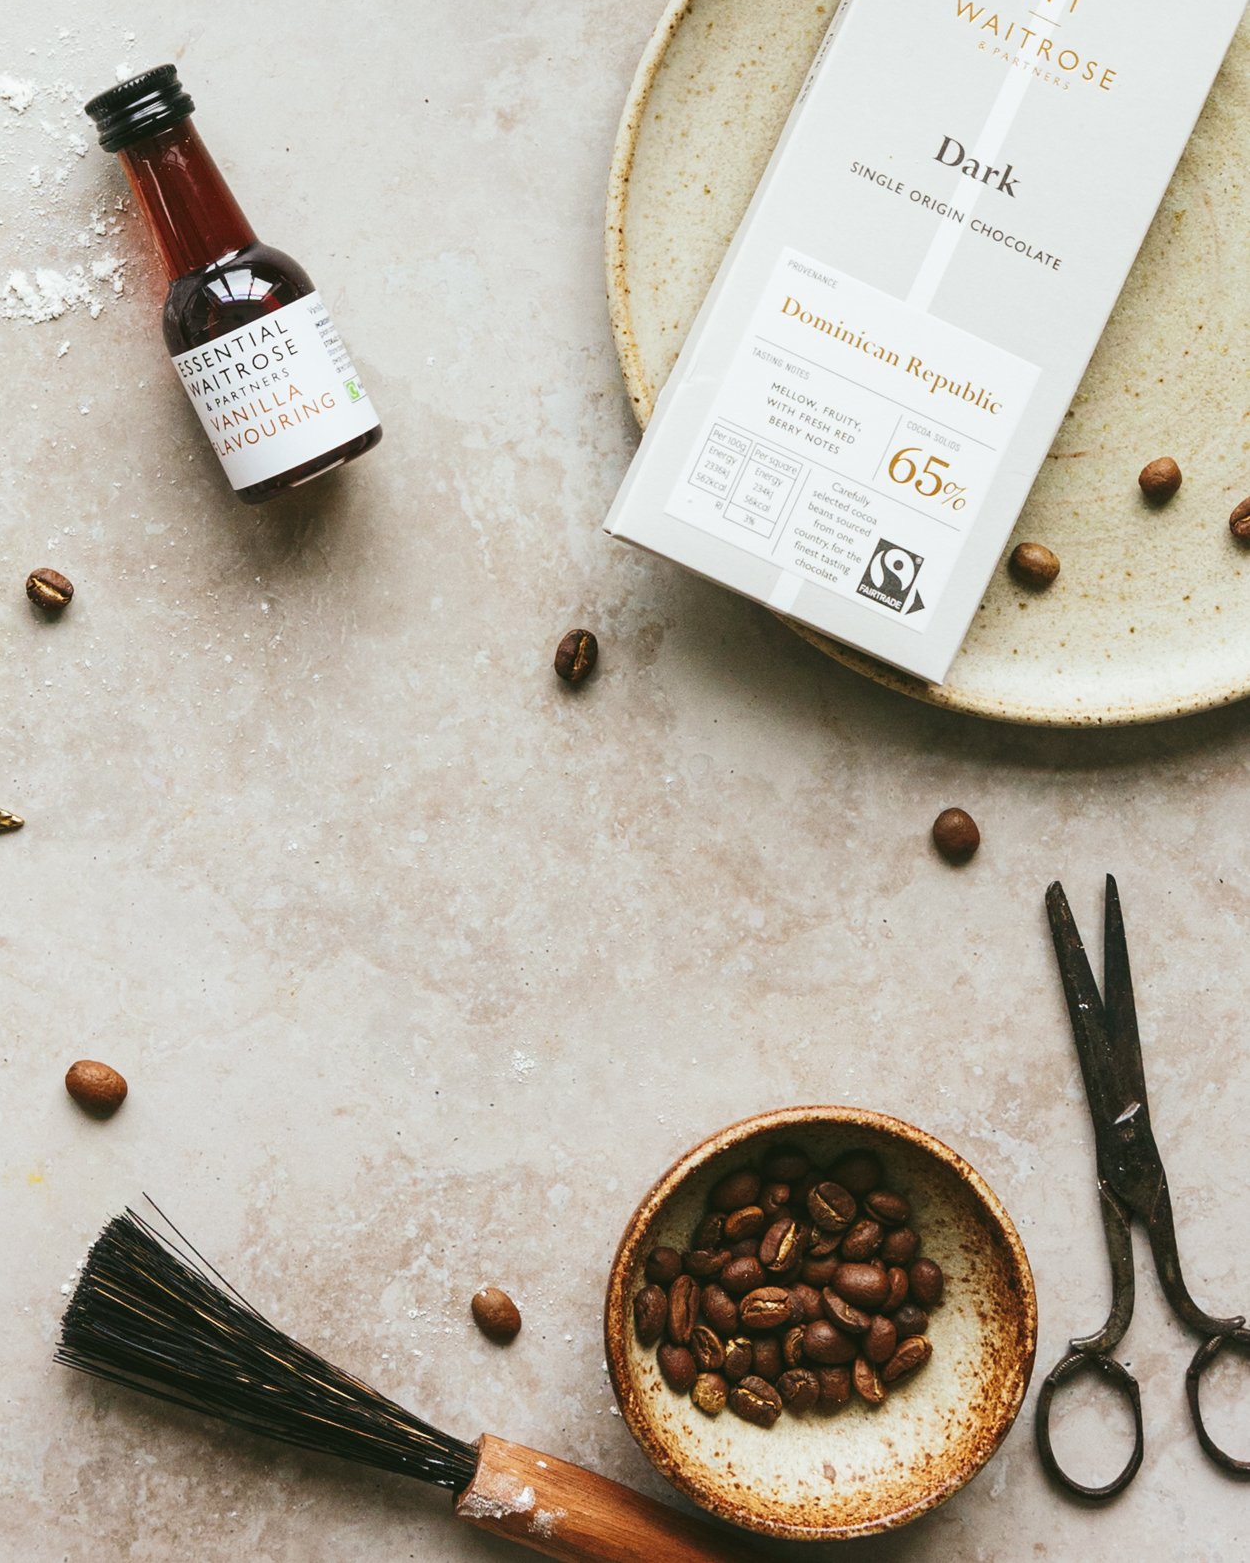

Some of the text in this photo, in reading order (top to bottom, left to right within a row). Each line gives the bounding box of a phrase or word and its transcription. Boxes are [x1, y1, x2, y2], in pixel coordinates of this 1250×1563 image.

[991, 46, 1071, 91] PARTNERS
[933, 135, 1022, 198] Dark
[850, 161, 1063, 271] SINGLE ORIGIN CHOCOLATE
[787, 259, 839, 289] PROVENANCE
[178, 319, 289, 378] ESSENTIAL
[752, 346, 810, 380] TASTING NOTES
[781, 295, 1004, 416] Dominican Republic
[187, 338, 299, 398] WAITROSE
[205, 367, 290, 412] & PARTNERS
[771, 382, 862, 432] MELLOW, FRUITY,
[210, 384, 303, 433] VANILLA
[766, 396, 855, 445] WITH FRESH RED
[768, 415, 840, 455] BERRY NOTES
[906, 420, 932, 438] COCOA
[708, 445, 737, 466] Energy
[769, 456, 798, 475] square
[754, 467, 783, 487] Energy
[831, 481, 871, 508] Carefully
[888, 447, 967, 511] 65%
[807, 502, 872, 538] beans sourced
[812, 489, 878, 526] selected cocoa
[813, 519, 854, 545] from one
[793, 540, 851, 576] finest tasting
[794, 557, 838, 583] chocolate
[831, 542, 845, 555] for
[846, 550, 862, 564] the
[858, 583, 903, 610] FAIRTRADE
